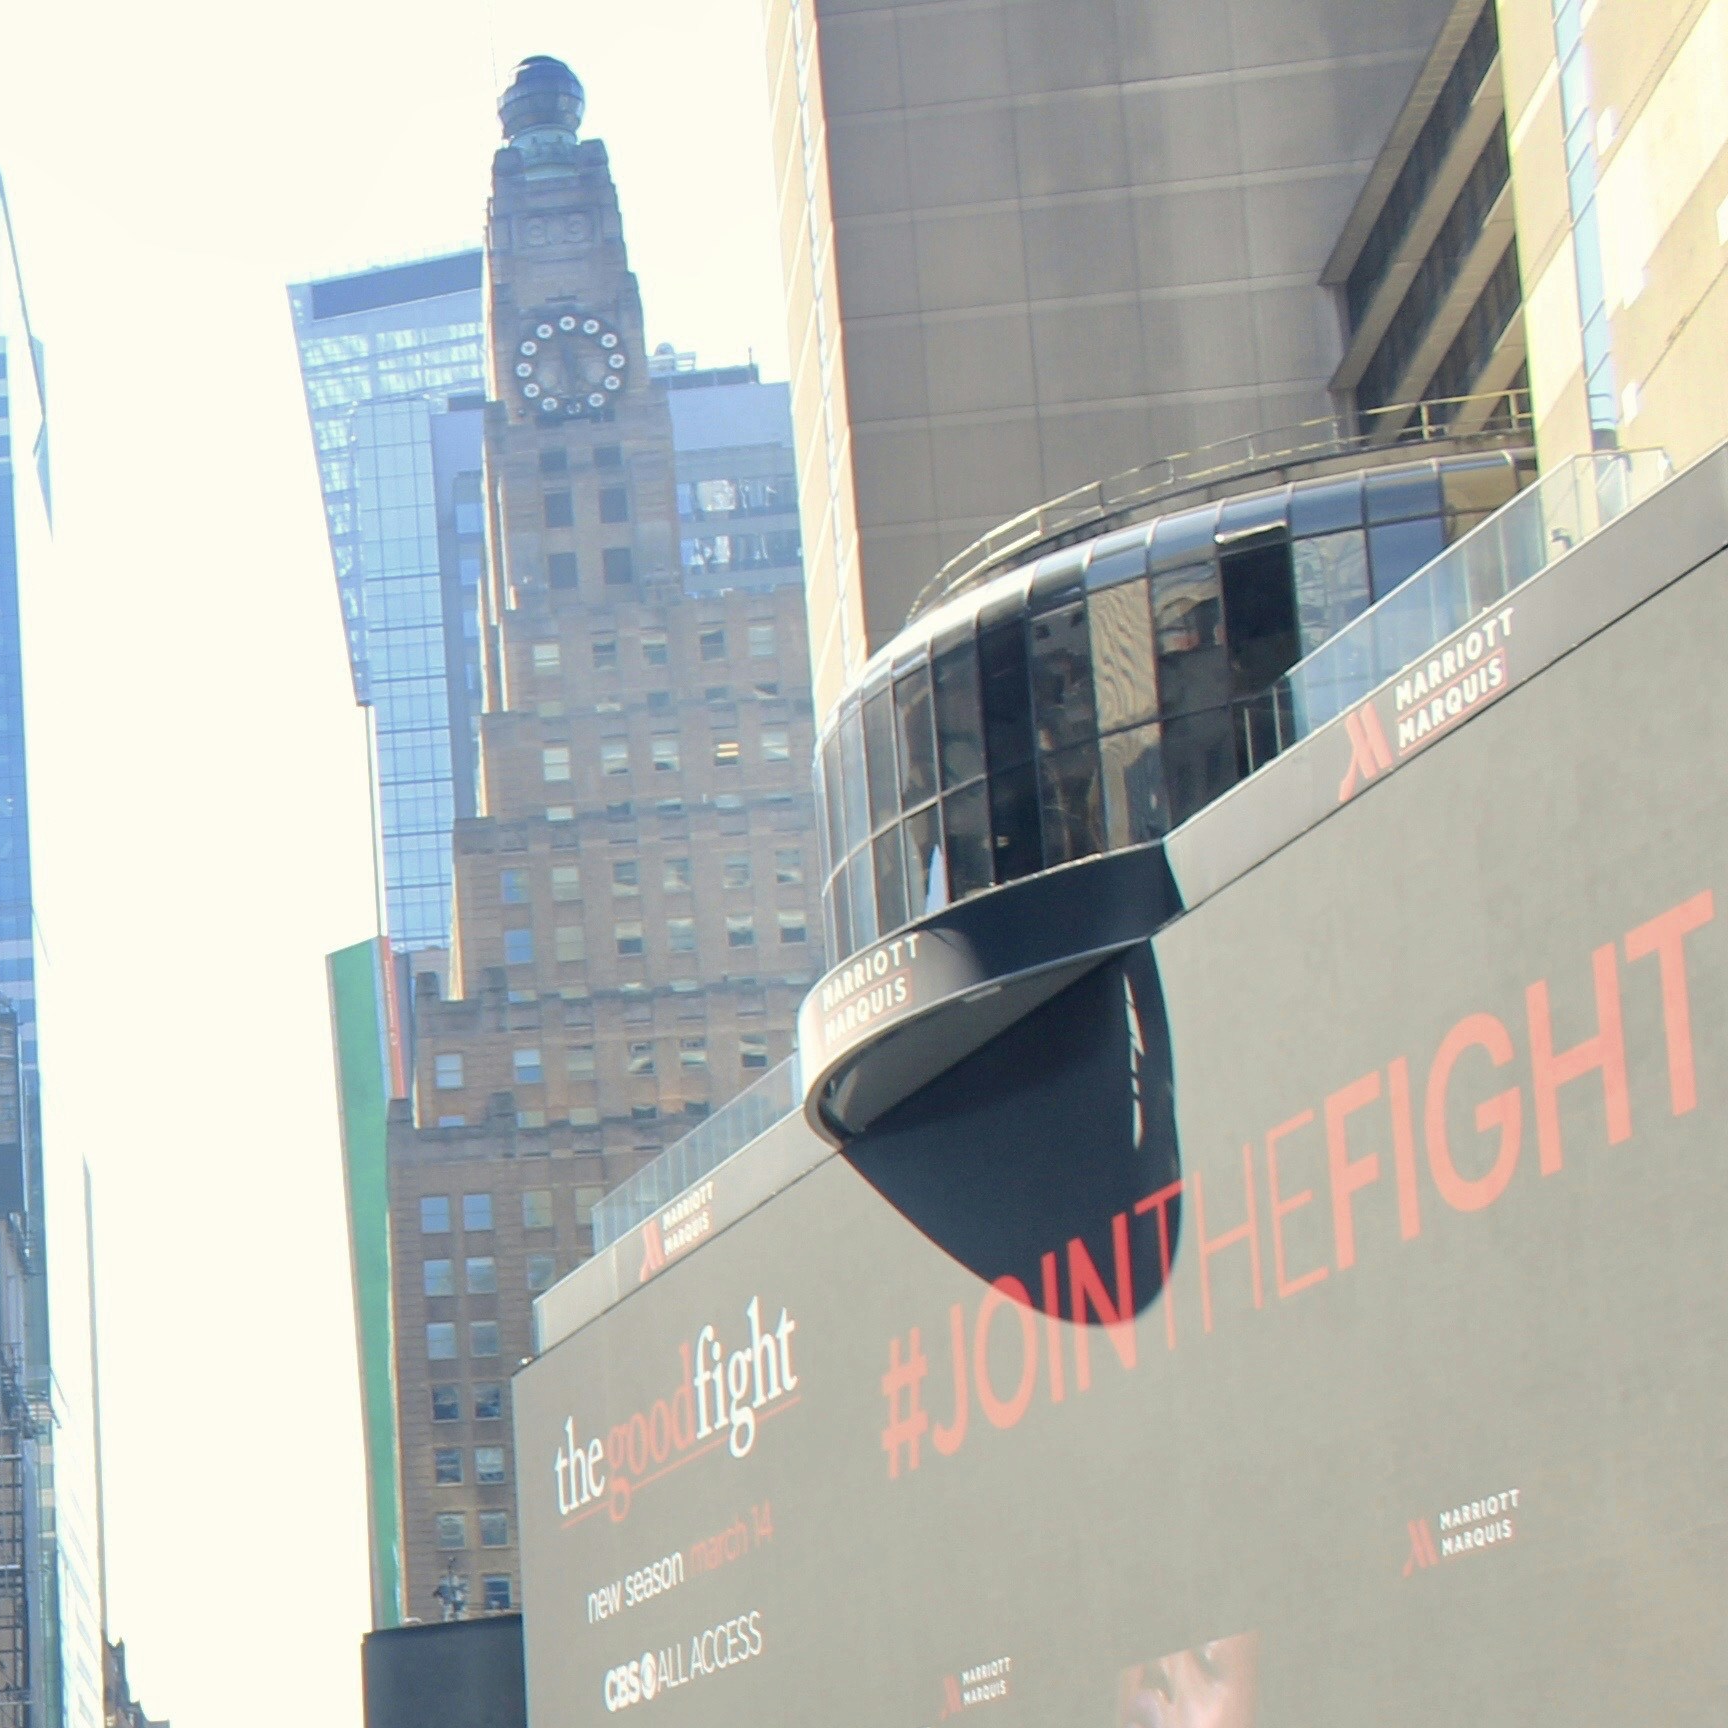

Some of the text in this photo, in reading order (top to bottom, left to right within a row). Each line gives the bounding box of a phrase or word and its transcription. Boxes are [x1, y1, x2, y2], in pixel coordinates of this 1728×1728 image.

[1393, 608, 1514, 711] MARRIOTT
[1397, 654, 1505, 750] MARQUIS
[823, 934, 921, 1011] MARRIOTT
[825, 976, 908, 1046] MARQUIS
[662, 1181, 714, 1231] MARRIOTT
[1440, 1489, 1521, 1531] MARRIOTT
[1442, 1519, 1513, 1557] MARQUIS
[587, 1500, 775, 1623] new season march 14
[605, 1611, 763, 1712] CBS ALL ACCESS
[962, 1656, 1011, 1687] MARRIOTT
[964, 1680, 1007, 1706] MARQUIS
